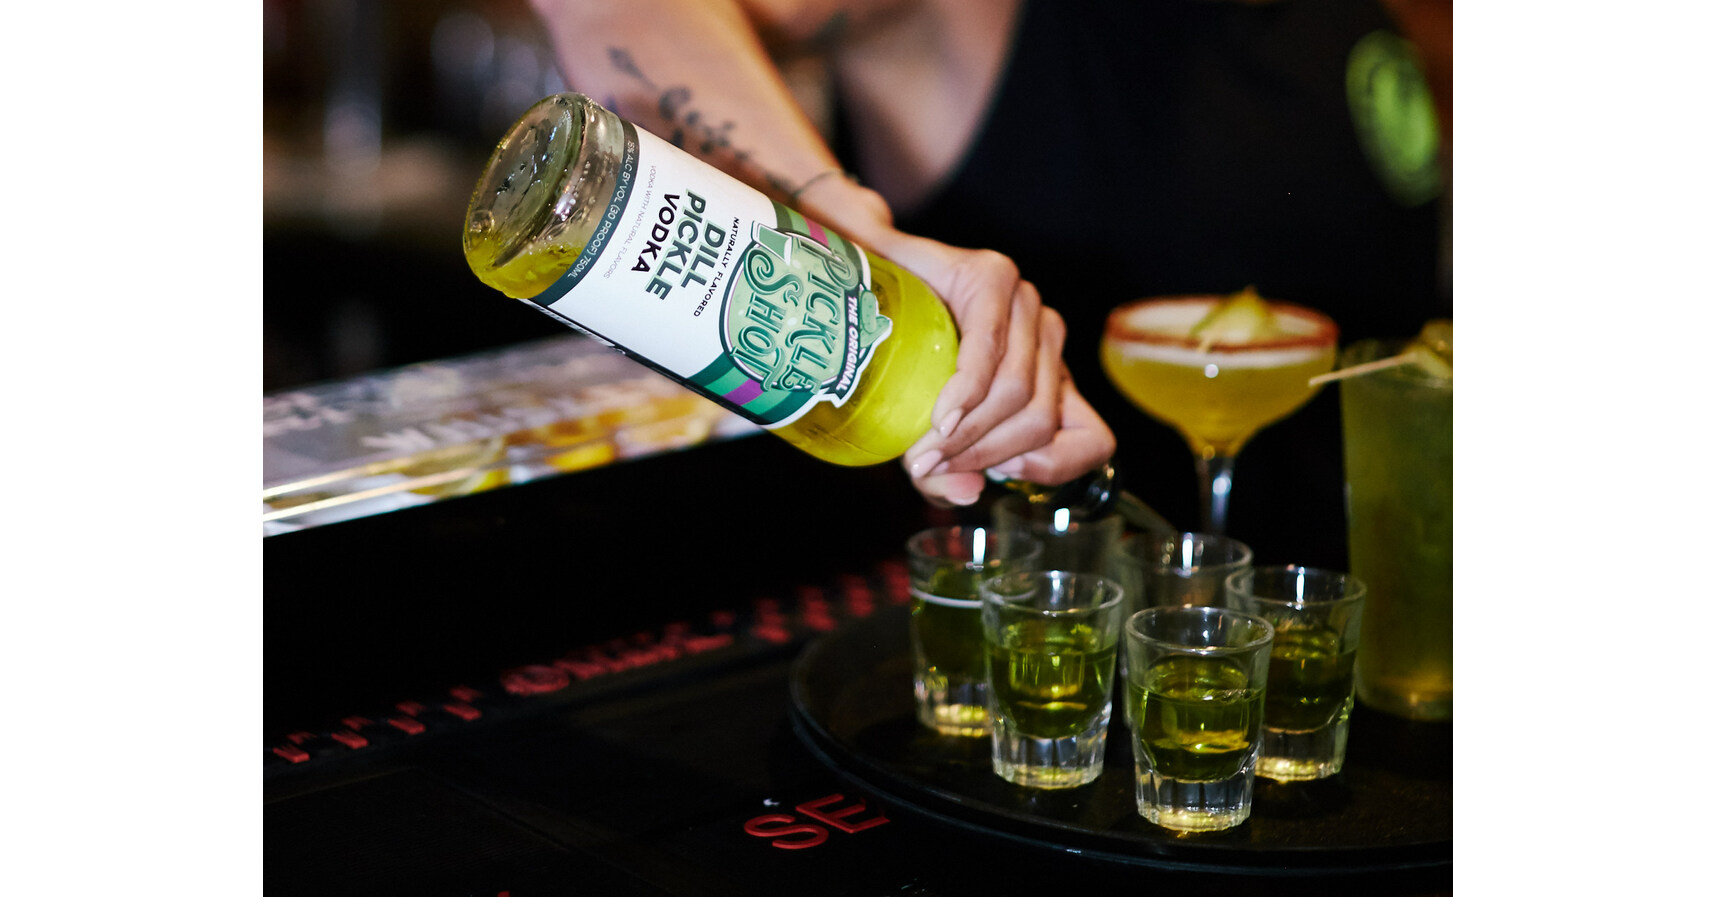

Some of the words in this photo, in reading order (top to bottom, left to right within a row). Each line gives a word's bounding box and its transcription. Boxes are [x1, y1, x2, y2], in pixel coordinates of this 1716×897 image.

[622, 171, 631, 186] BY
[625, 153, 634, 172] ALC
[647, 165, 657, 189] VODKA
[613, 185, 627, 203] VOL
[642, 190, 652, 210] WITH
[607, 204, 621, 220] (30
[624, 211, 645, 245] NATURAL
[586, 219, 613, 256] PROOF)
[631, 193, 680, 272] VODKA
[645, 189, 707, 301] PICKLE
[721, 216, 740, 269] NATURALLY
[567, 255, 592, 278] 750ML
[603, 247, 628, 279] FLAVORS
[680, 220, 726, 289] DILL
[693, 271, 724, 317] FLAVORED
[847, 296, 859, 326] THE
[731, 248, 804, 392] SHOT
[779, 236, 860, 394] PICKLE
[835, 325, 858, 391] ORIGINAL
